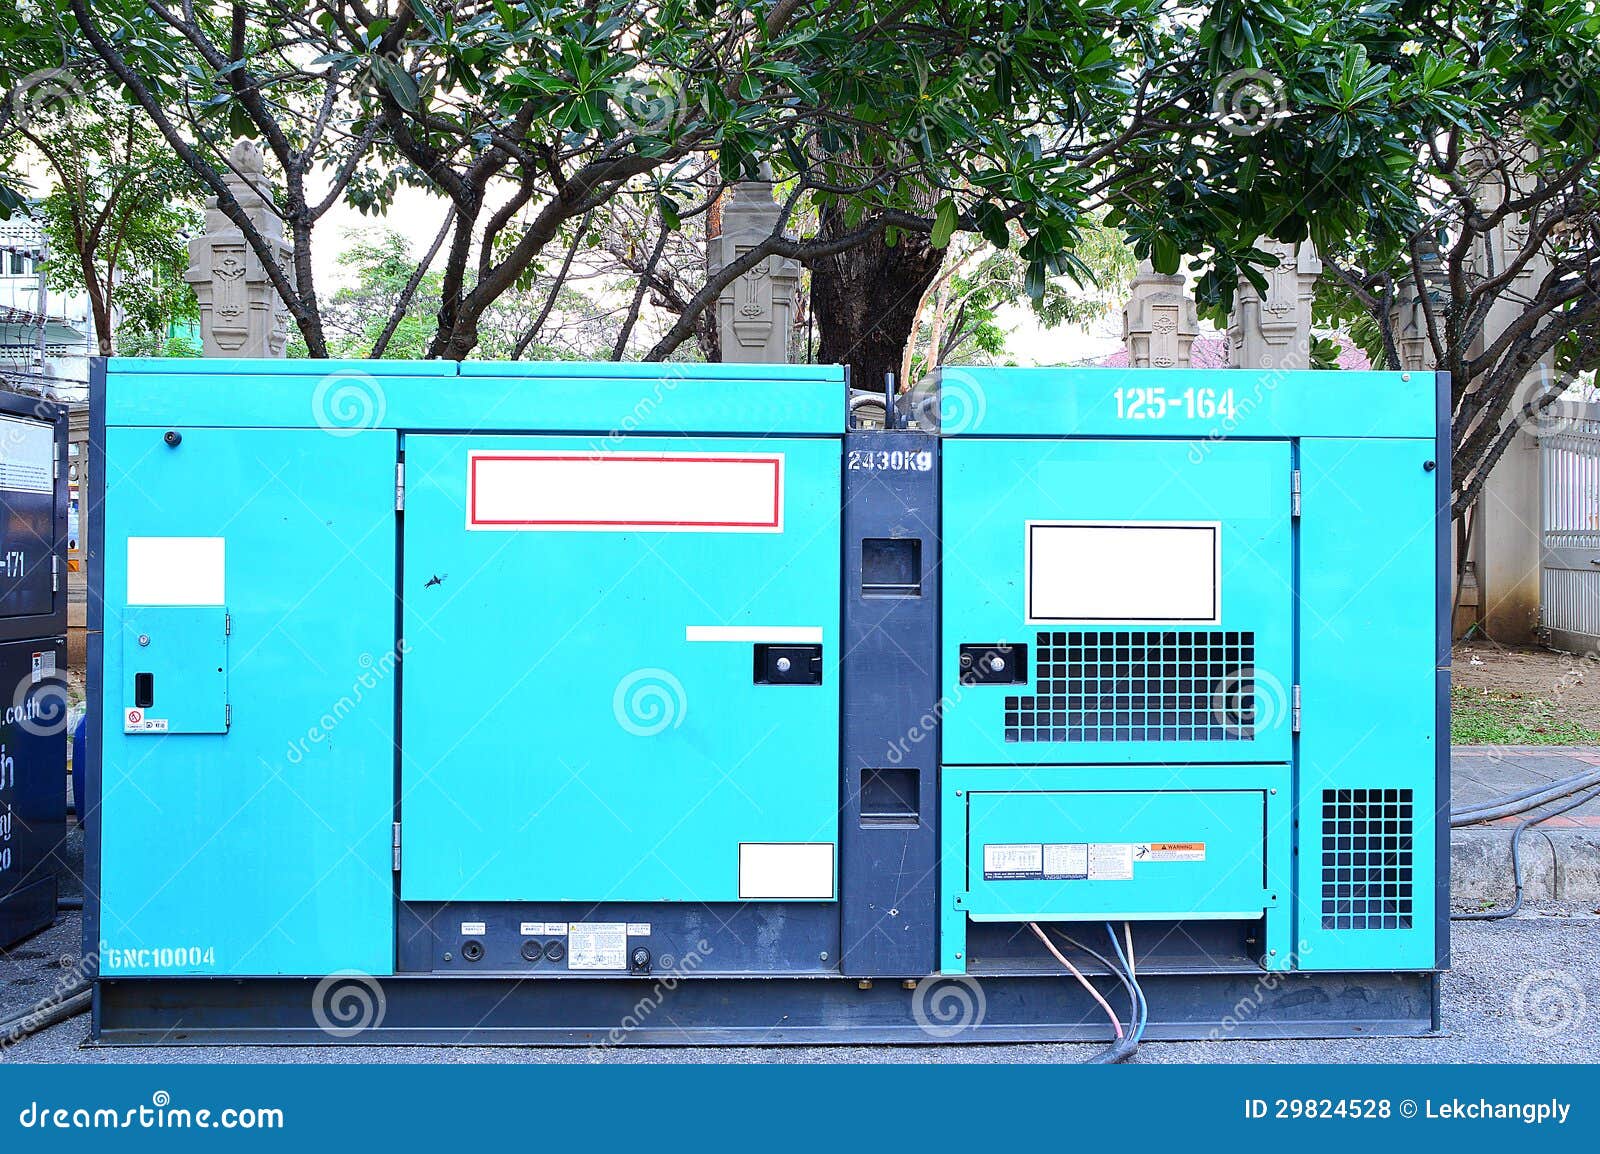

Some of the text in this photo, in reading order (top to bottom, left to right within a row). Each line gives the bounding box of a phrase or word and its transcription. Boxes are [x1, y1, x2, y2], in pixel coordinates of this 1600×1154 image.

[1113, 387, 1236, 419] 125-164
[848, 450, 932, 471] 2430Kg
[0, 697, 40, 727] .co.th
[108, 946, 215, 969] GNC10004
